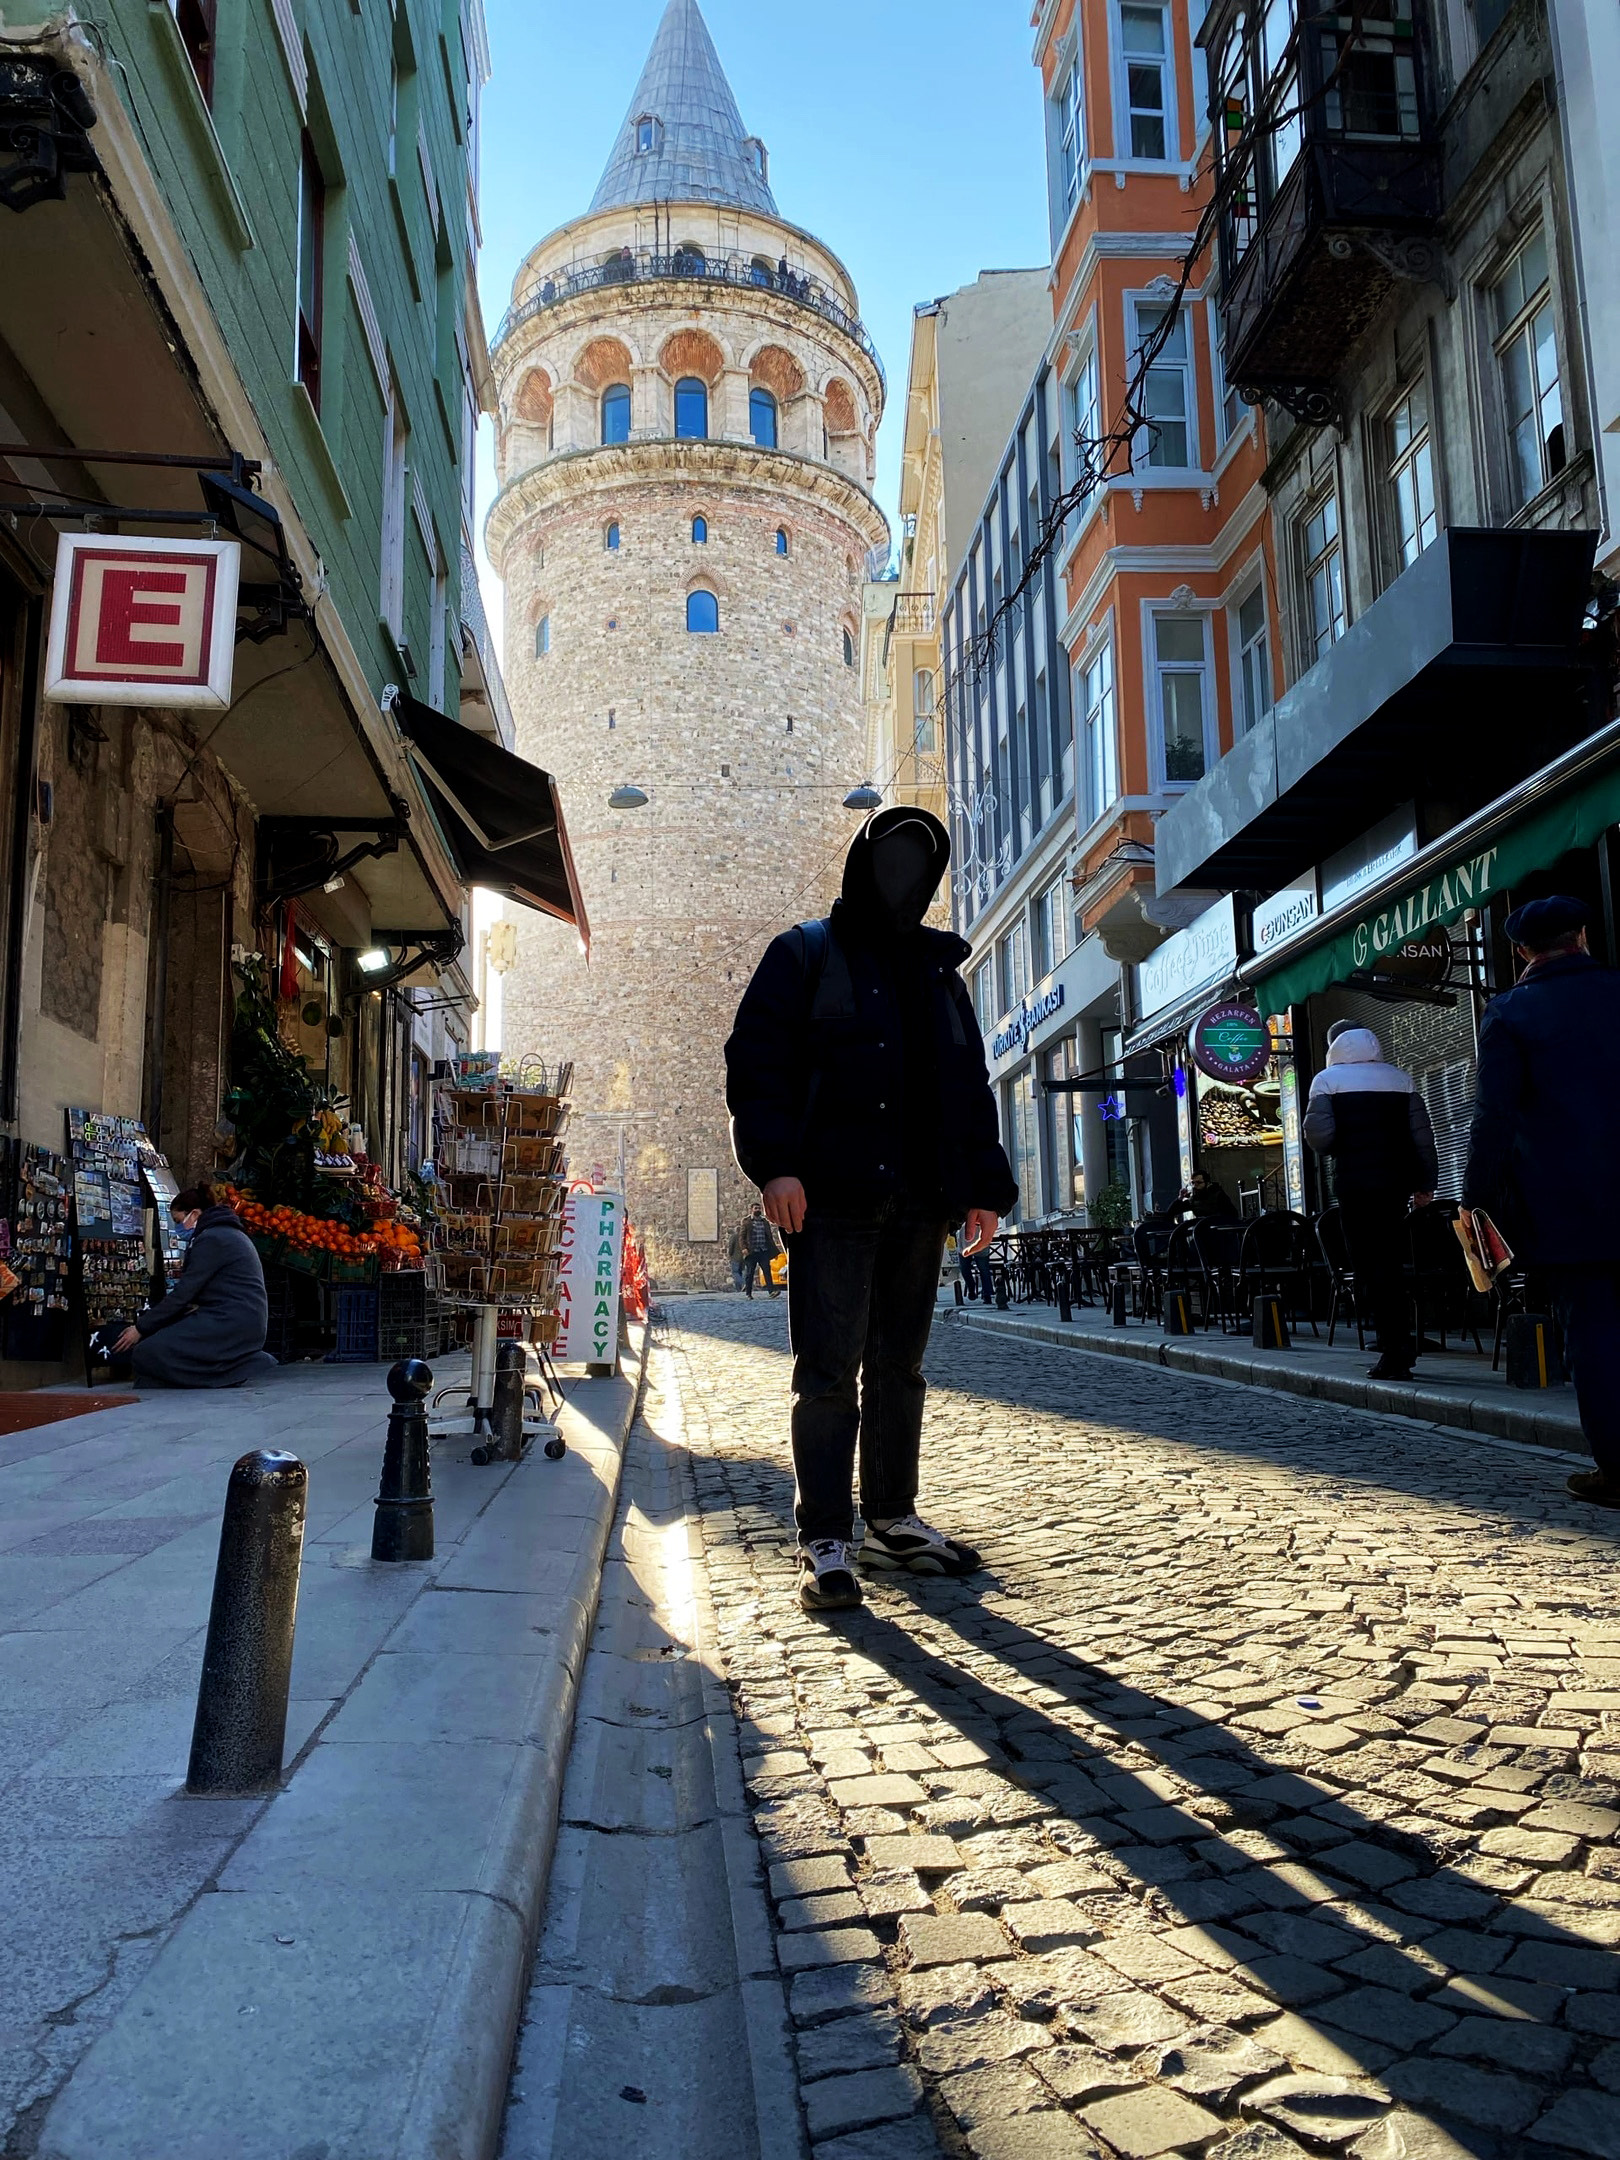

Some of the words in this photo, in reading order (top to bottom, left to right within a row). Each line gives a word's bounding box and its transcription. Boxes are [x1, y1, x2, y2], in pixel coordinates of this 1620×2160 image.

[95, 569, 187, 667] E
[1372, 846, 1498, 951] GALLANT
[1145, 952, 1183, 994] Coffee
[1025, 984, 1065, 1031] BANKASI
[1210, 1009, 1256, 1025] HEZARFEN
[1218, 1031, 1249, 1044] Coffee
[1217, 1062, 1252, 1073] GALATA
[551, 1201, 577, 1358] ECZANE
[592, 1201, 615, 1358] PHARMACY
